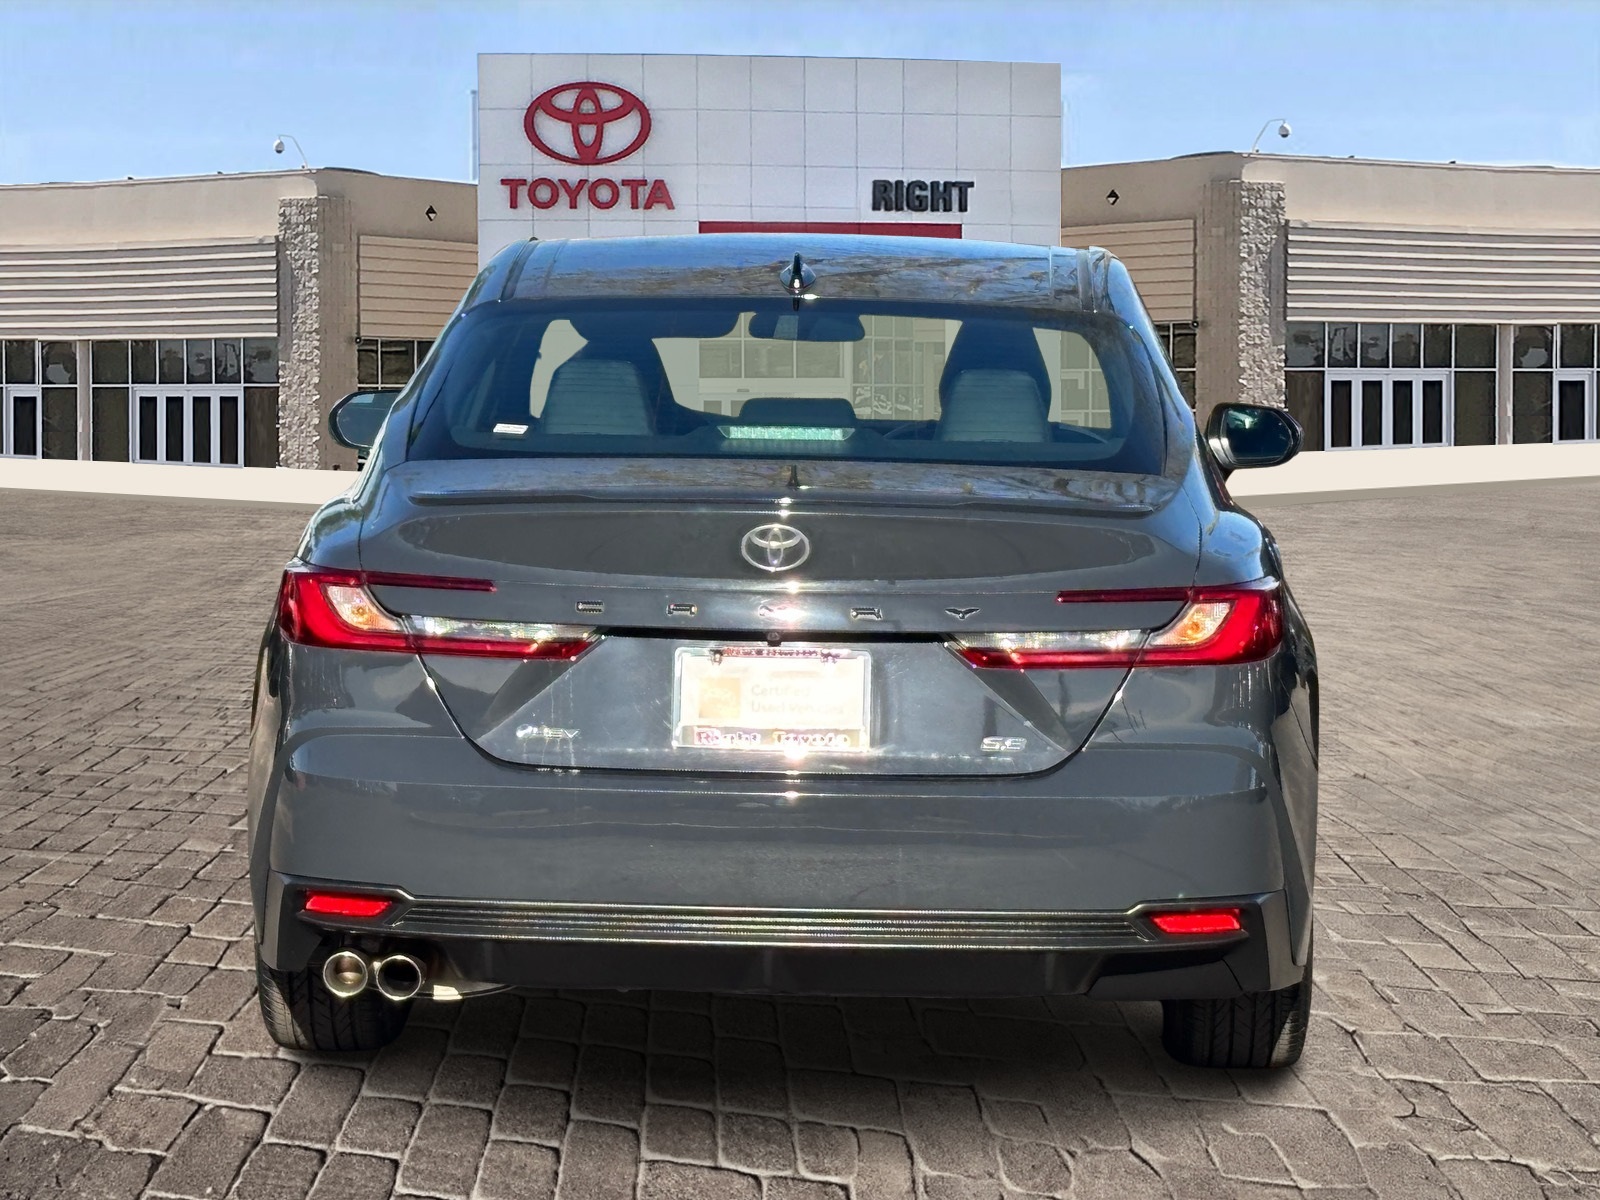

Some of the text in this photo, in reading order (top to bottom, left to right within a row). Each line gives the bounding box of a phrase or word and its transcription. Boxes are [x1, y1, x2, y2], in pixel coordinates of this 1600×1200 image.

[501, 178, 676, 211] TOYOTA
[872, 179, 976, 212] RIGHT
[981, 736, 1027, 752] SE
